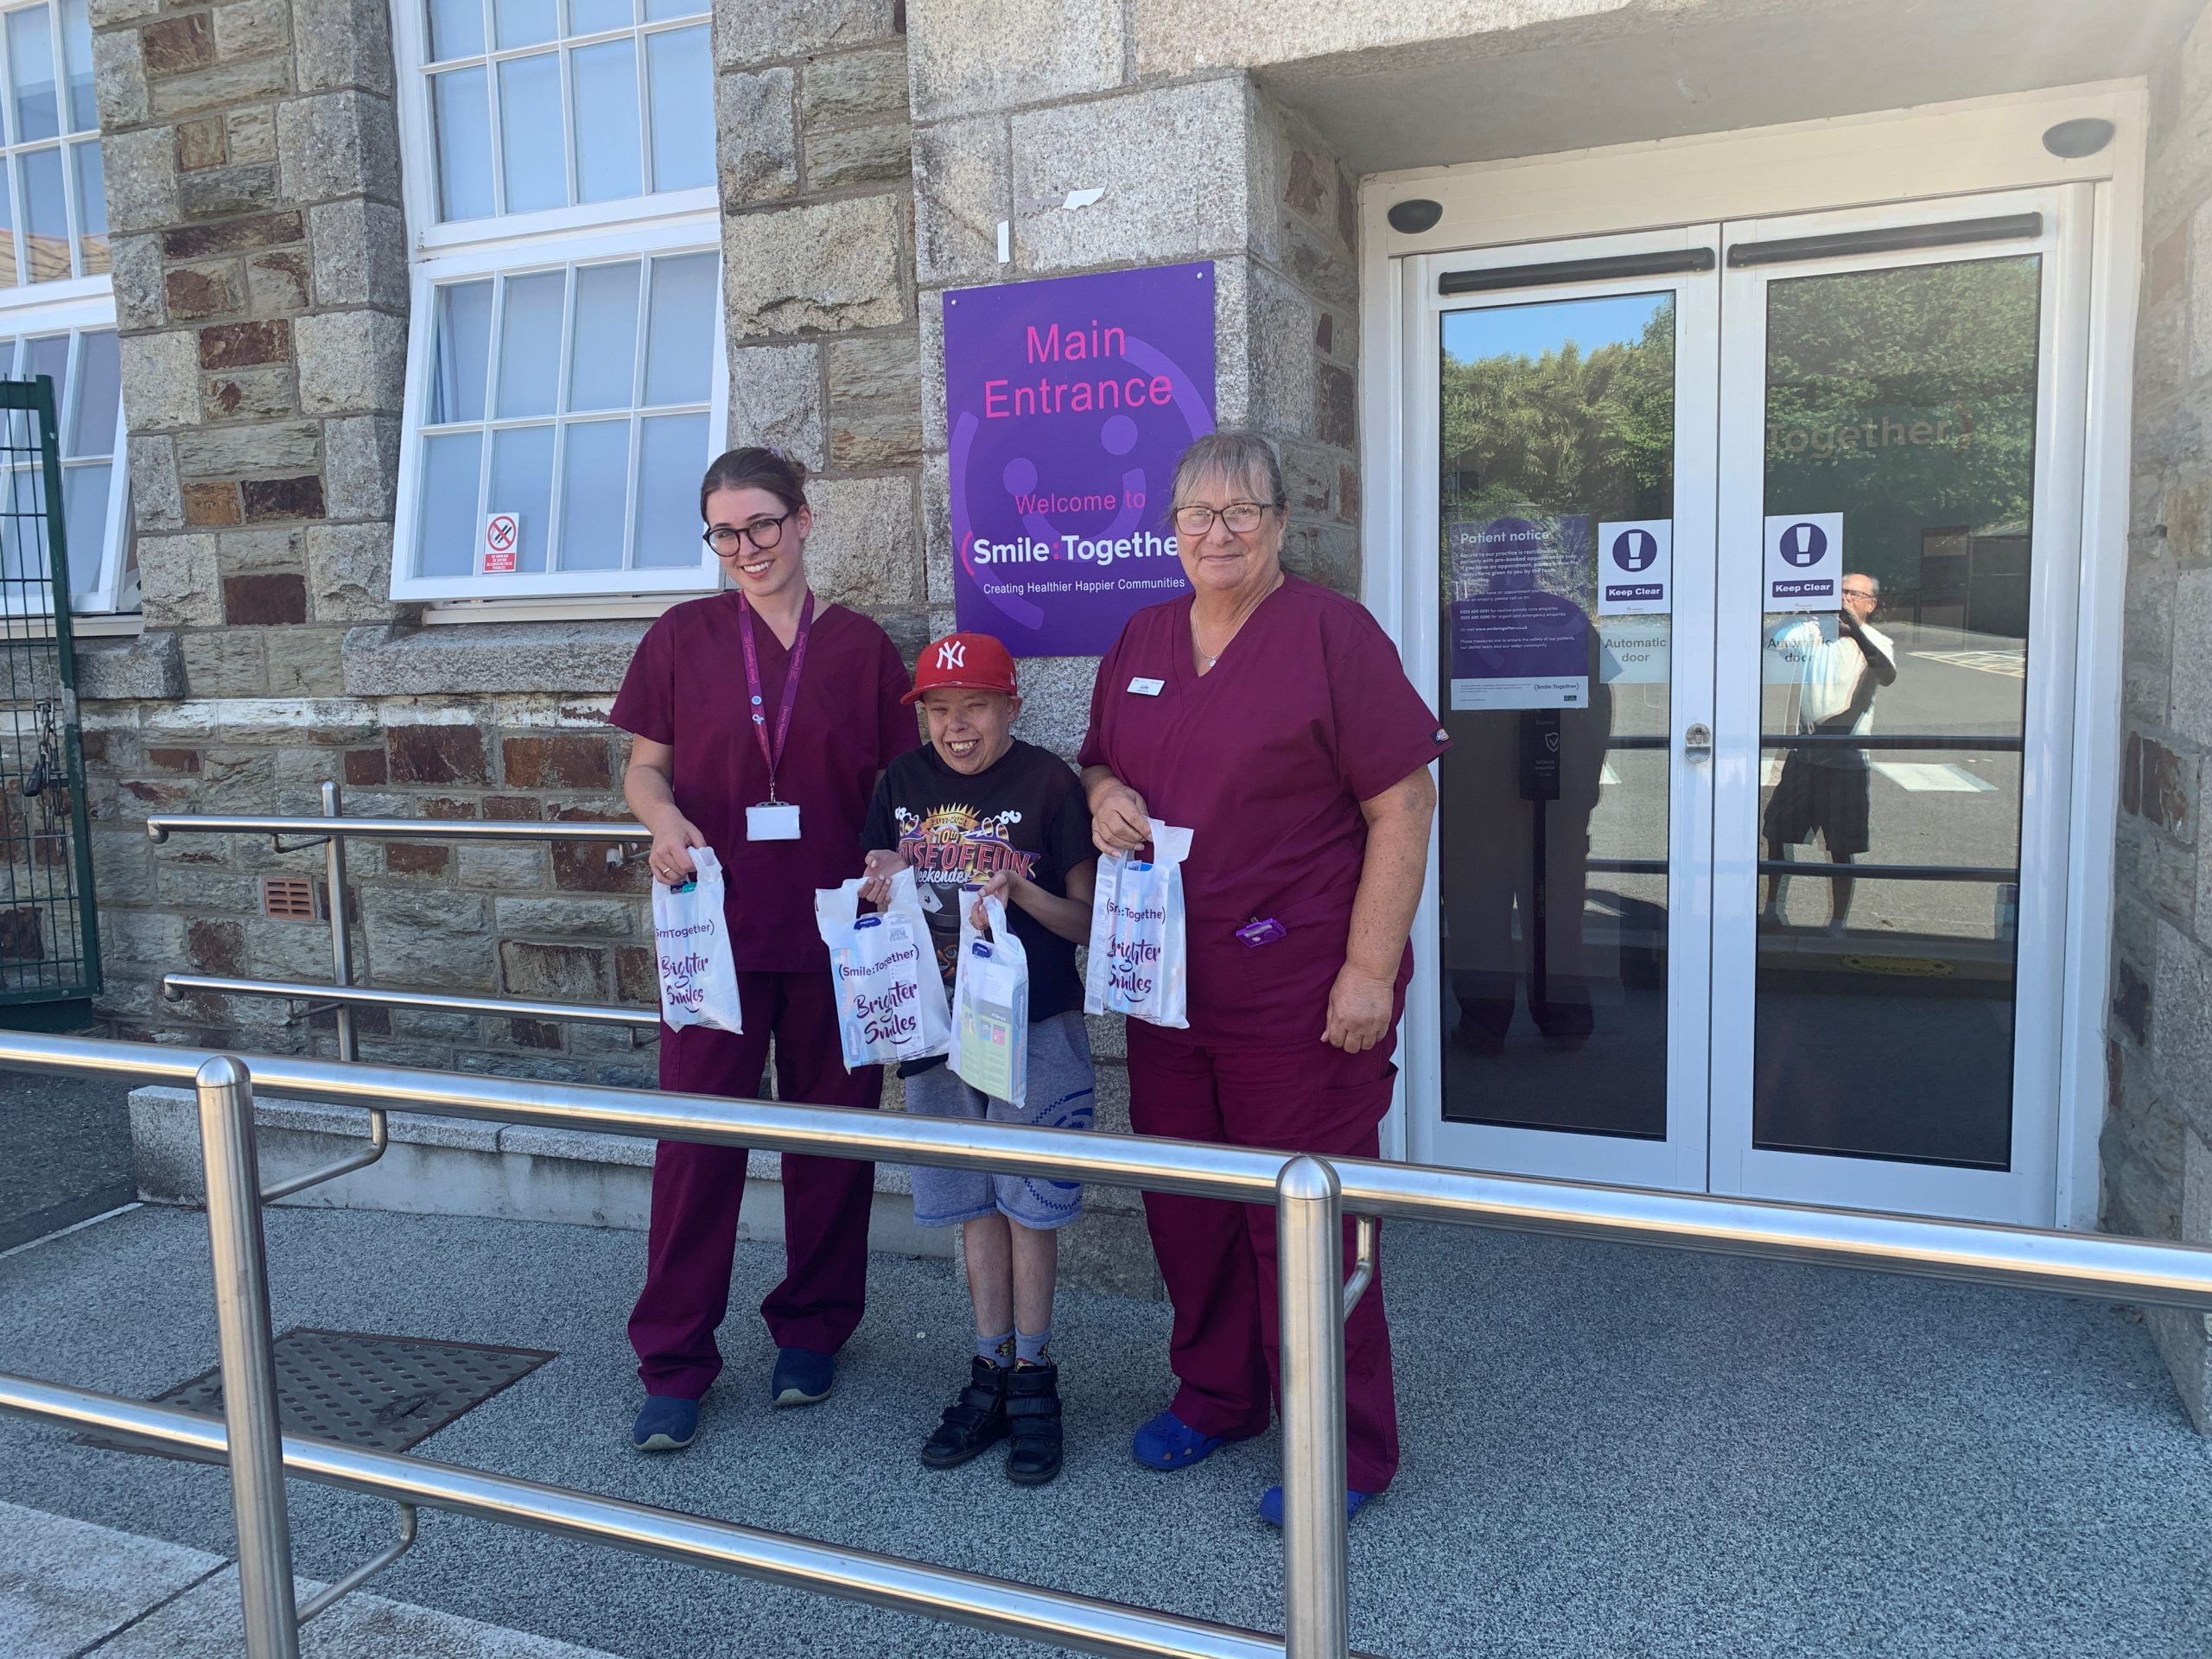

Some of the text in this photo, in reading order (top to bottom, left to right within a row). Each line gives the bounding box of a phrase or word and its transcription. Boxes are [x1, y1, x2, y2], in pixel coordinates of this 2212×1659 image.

[1027, 320, 1125, 364] Main
[985, 373, 1173, 418] Entrance
[1015, 490, 1146, 515] Welcome to
[1460, 530, 1548, 543] Patient notice
[961, 531, 1179, 576] (Smile:Togethe
[983, 577, 1185, 595] Creating Healthier Happier Communities
[1609, 588, 1632, 598] Keep
[1776, 584, 1801, 594] Keep
[1605, 639, 1667, 649] Automatic
[937, 641, 966, 670] NY
[1622, 652, 1650, 663] door
[1535, 683, 1579, 691] (Smile:Together)
[936, 830, 959, 844] 10th
[942, 843, 974, 869] OF
[976, 845, 1030, 878] FUN
[854, 982, 918, 1023] Brighter
[864, 1014, 916, 1045] Smiles
